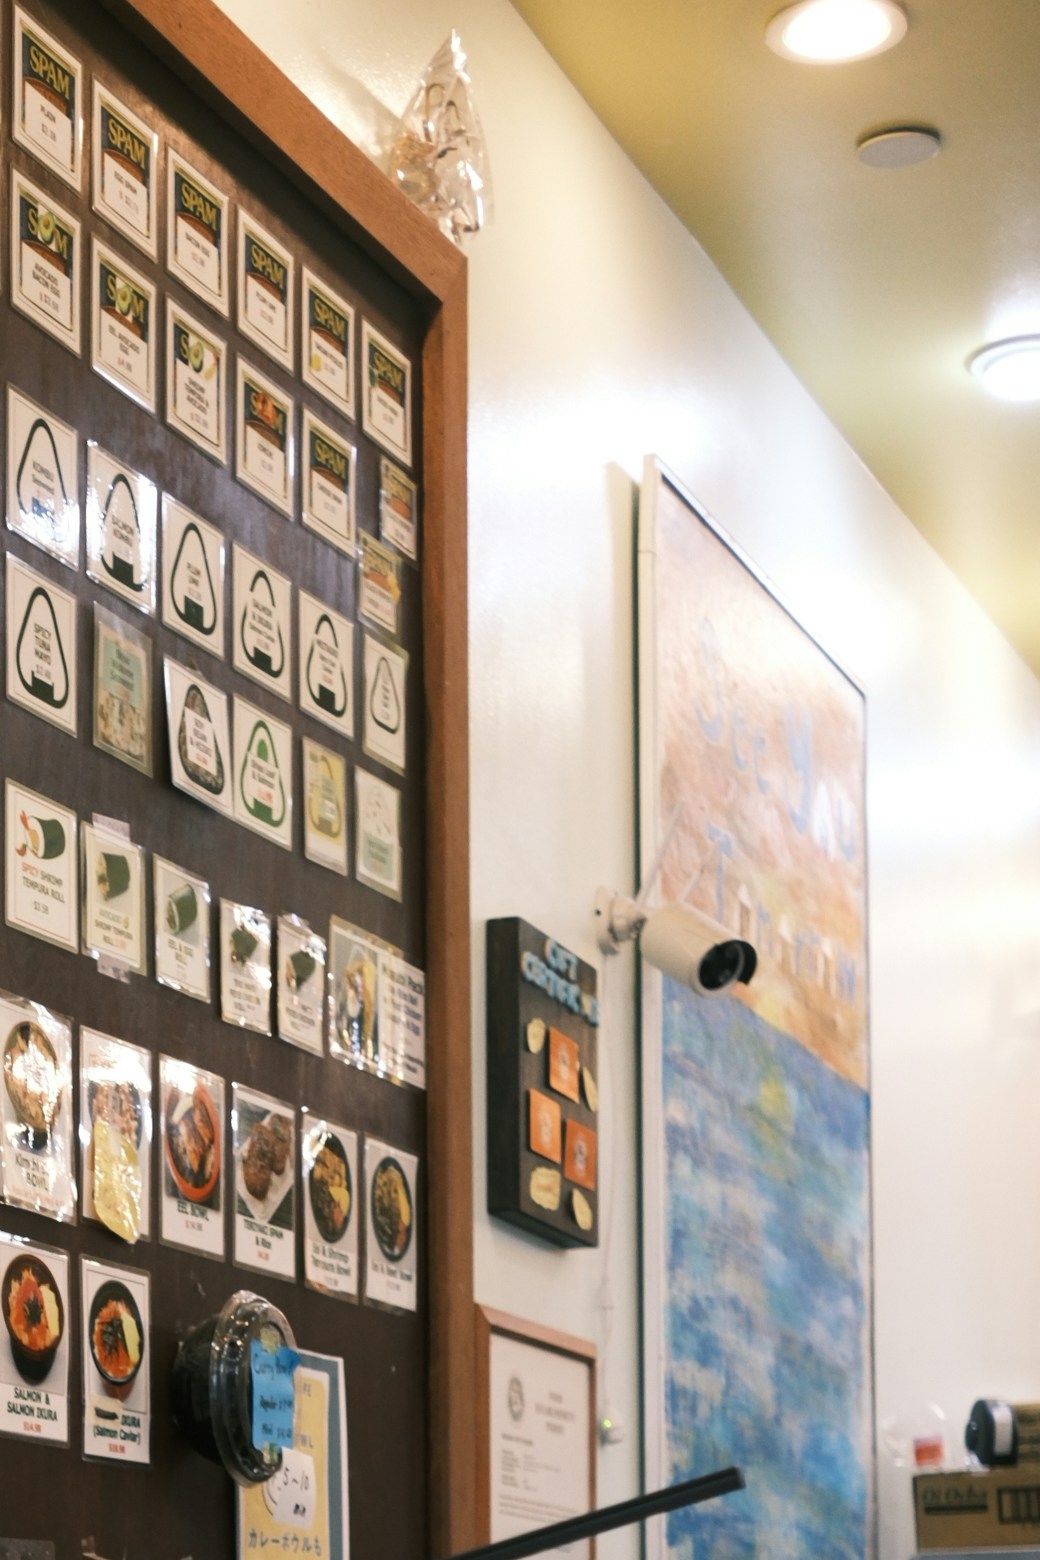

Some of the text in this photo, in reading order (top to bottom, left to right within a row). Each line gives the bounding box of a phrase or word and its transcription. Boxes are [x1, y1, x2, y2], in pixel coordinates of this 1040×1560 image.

[29, 45, 70, 99] SPAM
[108, 118, 146, 169] SPAM
[180, 183, 217, 231] SPAM
[251, 242, 285, 290] SPAM
[314, 297, 347, 343] SPAM
[373, 350, 405, 394] SPAM
[315, 437, 347, 481] SPAM
[6, 1401, 58, 1422] SALMON IKURA
[14, 1386, 42, 1404] SALMON
